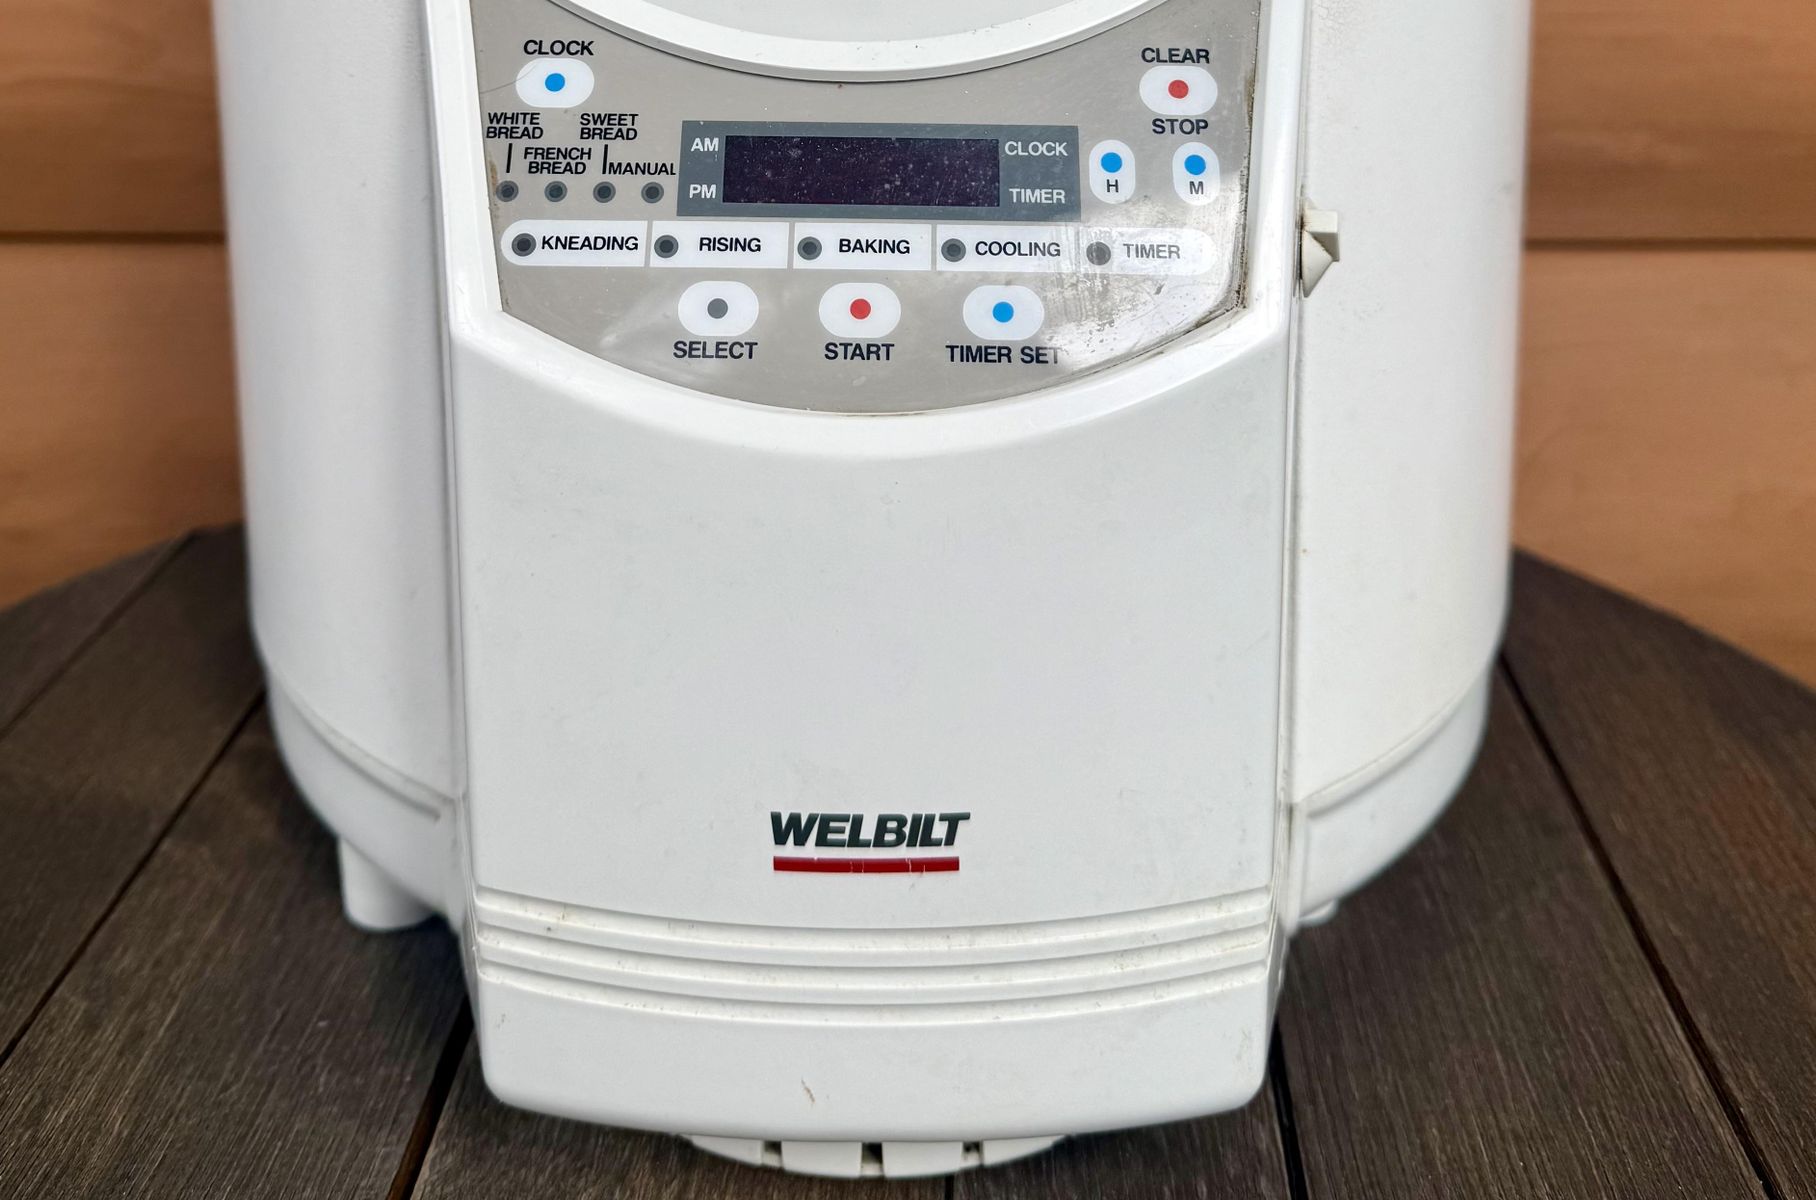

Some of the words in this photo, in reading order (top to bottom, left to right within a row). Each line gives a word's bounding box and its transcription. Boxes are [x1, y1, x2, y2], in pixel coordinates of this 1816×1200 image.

[523, 39, 595, 56] CLOCK
[1140, 47, 1211, 64] CLEAR
[487, 112, 541, 126] WHITE
[579, 113, 639, 127] SWEET
[1151, 118, 1209, 135] STOP
[485, 126, 544, 140] BREAD
[579, 127, 638, 141] BREAD
[690, 137, 720, 152] AM
[1004, 141, 1068, 157] CLOCK
[523, 147, 592, 161] FRENCH
[527, 161, 587, 176] BREAD
[607, 161, 677, 176] MANUAL
[688, 184, 717, 199] PM
[1105, 178, 1120, 193] H
[1189, 180, 1205, 195] M
[1008, 188, 1066, 204] TIMER
[541, 235, 639, 251] KNEADING
[698, 237, 762, 253] RISING
[838, 238, 911, 255] BAKING
[974, 240, 1062, 258] COOLING
[1122, 243, 1181, 260] TIMER
[672, 341, 759, 360] SELECT
[823, 343, 895, 362] START
[945, 344, 1013, 364] TIMER
[1019, 345, 1064, 365] SET
[770, 811, 971, 848] WELBILT
